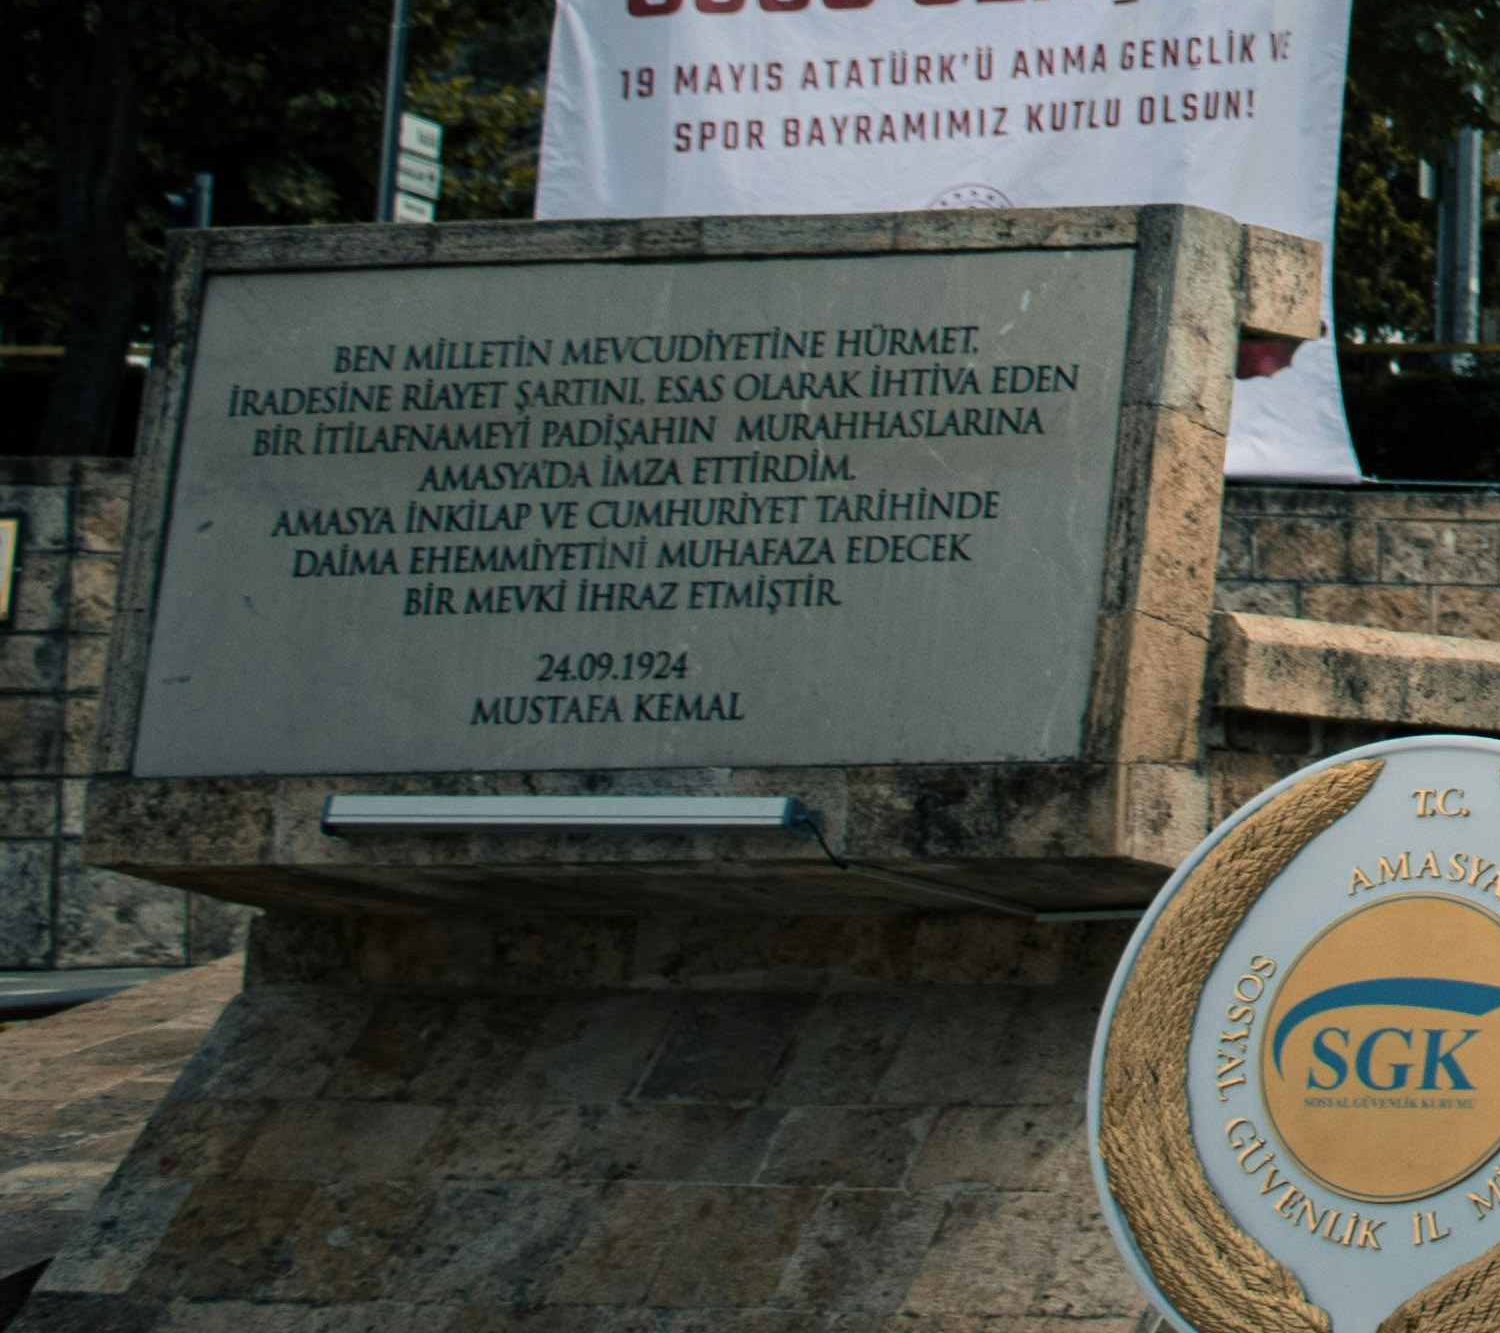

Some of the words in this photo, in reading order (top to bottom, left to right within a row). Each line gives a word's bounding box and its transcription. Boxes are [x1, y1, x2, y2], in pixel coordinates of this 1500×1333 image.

[618, 69, 656, 100] 19
[672, 61, 782, 95] MAYIS
[801, 48, 993, 90] ATATÜRK'Ü
[1011, 42, 1106, 78] ANMA
[1118, 30, 1257, 71] GENÇLİK
[672, 119, 764, 153] SPOR
[782, 106, 1007, 147] BAYRAMIMIZ
[1025, 97, 1120, 133] KUTLU
[1137, 88, 1254, 126] OLSUN!
[333, 343, 395, 373] BEN
[403, 334, 552, 371] MİLLETİN
[561, 326, 824, 366] MEVCUDİYETİNE
[228, 380, 392, 417] İRADESİNE
[401, 377, 507, 411] RİAYET
[655, 373, 725, 404] ESAS
[732, 369, 861, 402] OLARAK
[870, 362, 980, 398] İHTİVA
[990, 363, 1079, 394] EDEN
[251, 423, 305, 457] BİR
[312, 410, 529, 455] İTİLAFNAMEYİ
[541, 412, 715, 453] PADİŞAHIN
[736, 406, 1043, 442] MURAHHASLARINA
[600, 447, 682, 487] İMZA
[270, 506, 395, 537] AMASYA
[539, 500, 579, 530] VE
[586, 491, 806, 529] CUMHURİYET
[816, 486, 999, 523] TARİHİNDE
[292, 542, 398, 578] DAİMA
[409, 535, 645, 575] EHEMMİYETİNİ
[656, 536, 834, 568] MUHAFAZA
[846, 532, 971, 564] EDECEK
[402, 581, 457, 616] BİR
[463, 578, 566, 614] MEVKİ
[576, 577, 678, 612] İHRAZ
[536, 650, 687, 682] 24.09.1924
[470, 693, 621, 726] MUSTAFA
[633, 691, 744, 723] KEMAL
[1411, 788, 1471, 818] T.C.
[1216, 952, 1277, 1104] SOSYAL
[1306, 1026, 1481, 1093] SGK
[1226, 1117, 1386, 1251] GÜVENLİK
[1413, 1209, 1452, 1246] İL
